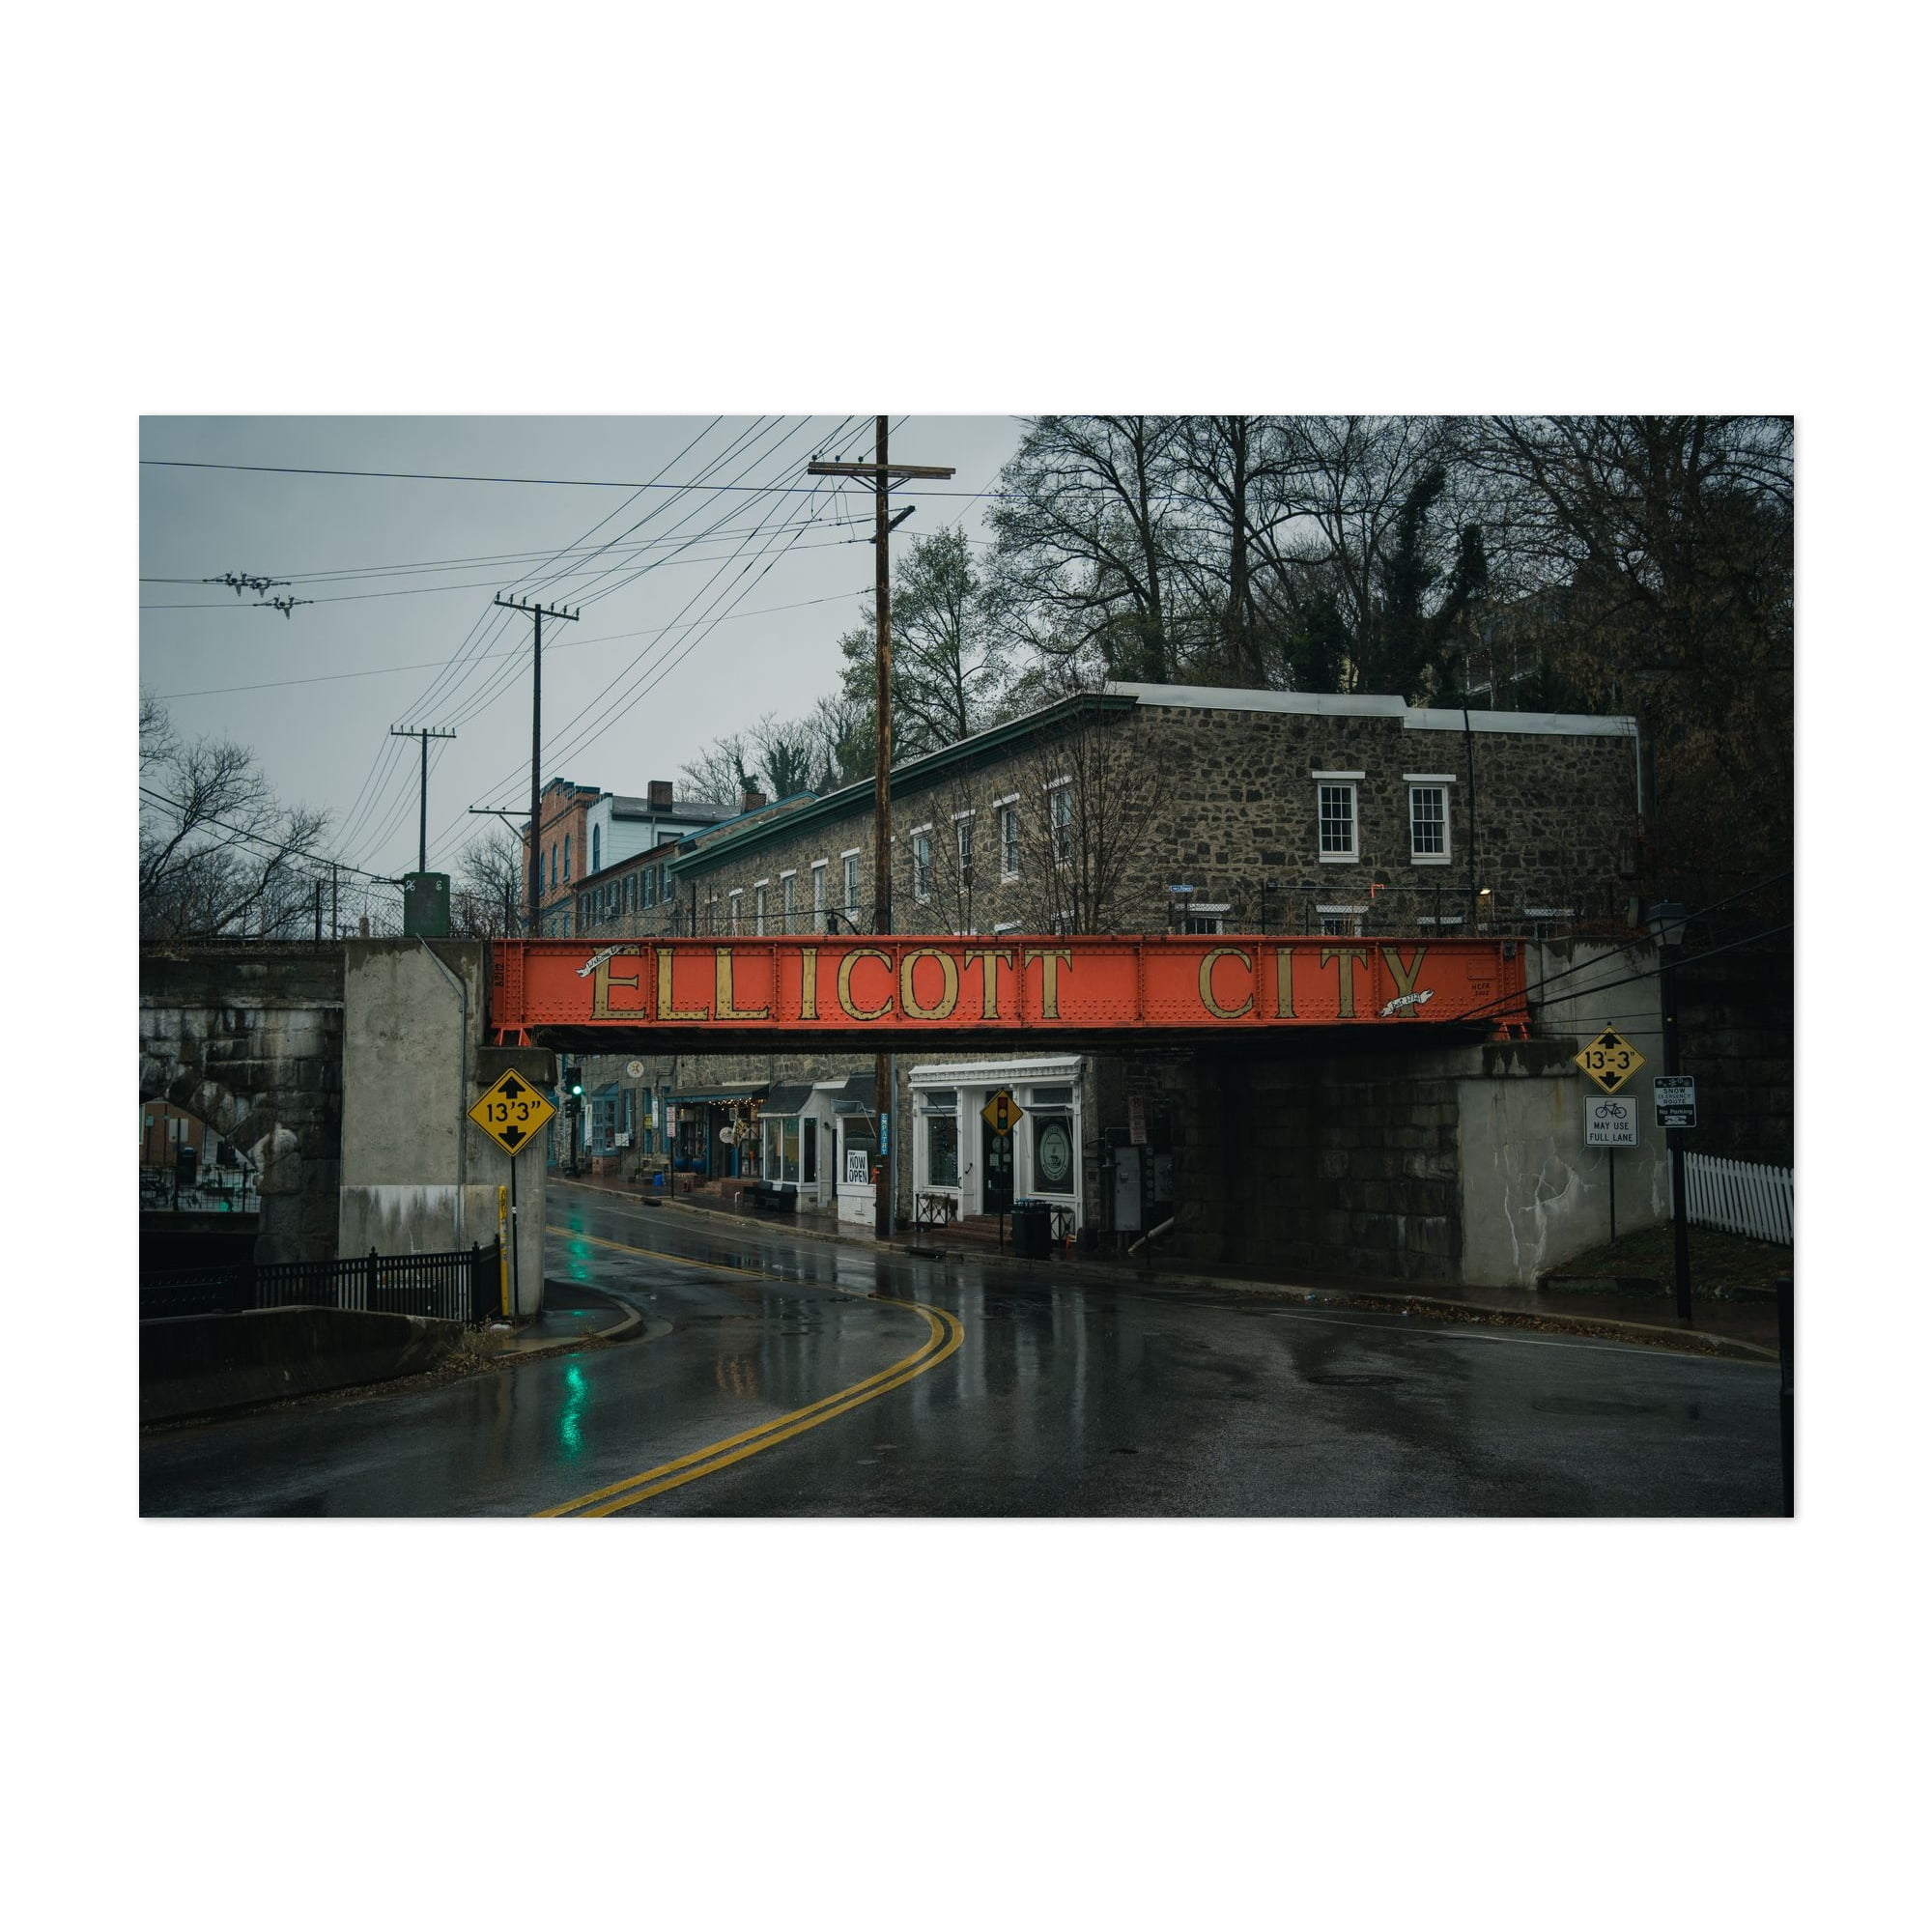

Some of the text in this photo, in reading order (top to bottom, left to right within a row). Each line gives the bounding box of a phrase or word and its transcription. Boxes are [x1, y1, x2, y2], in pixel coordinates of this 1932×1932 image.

[590, 946, 1430, 1021] ELLICOTT CITY
[486, 1100, 541, 1123] 13'3"
[1594, 1122, 1630, 1130] MAY USE
[1589, 1133, 1634, 1142] FULL LANE
[850, 1156, 866, 1169] NOW
[849, 1170, 867, 1183] OPEN
